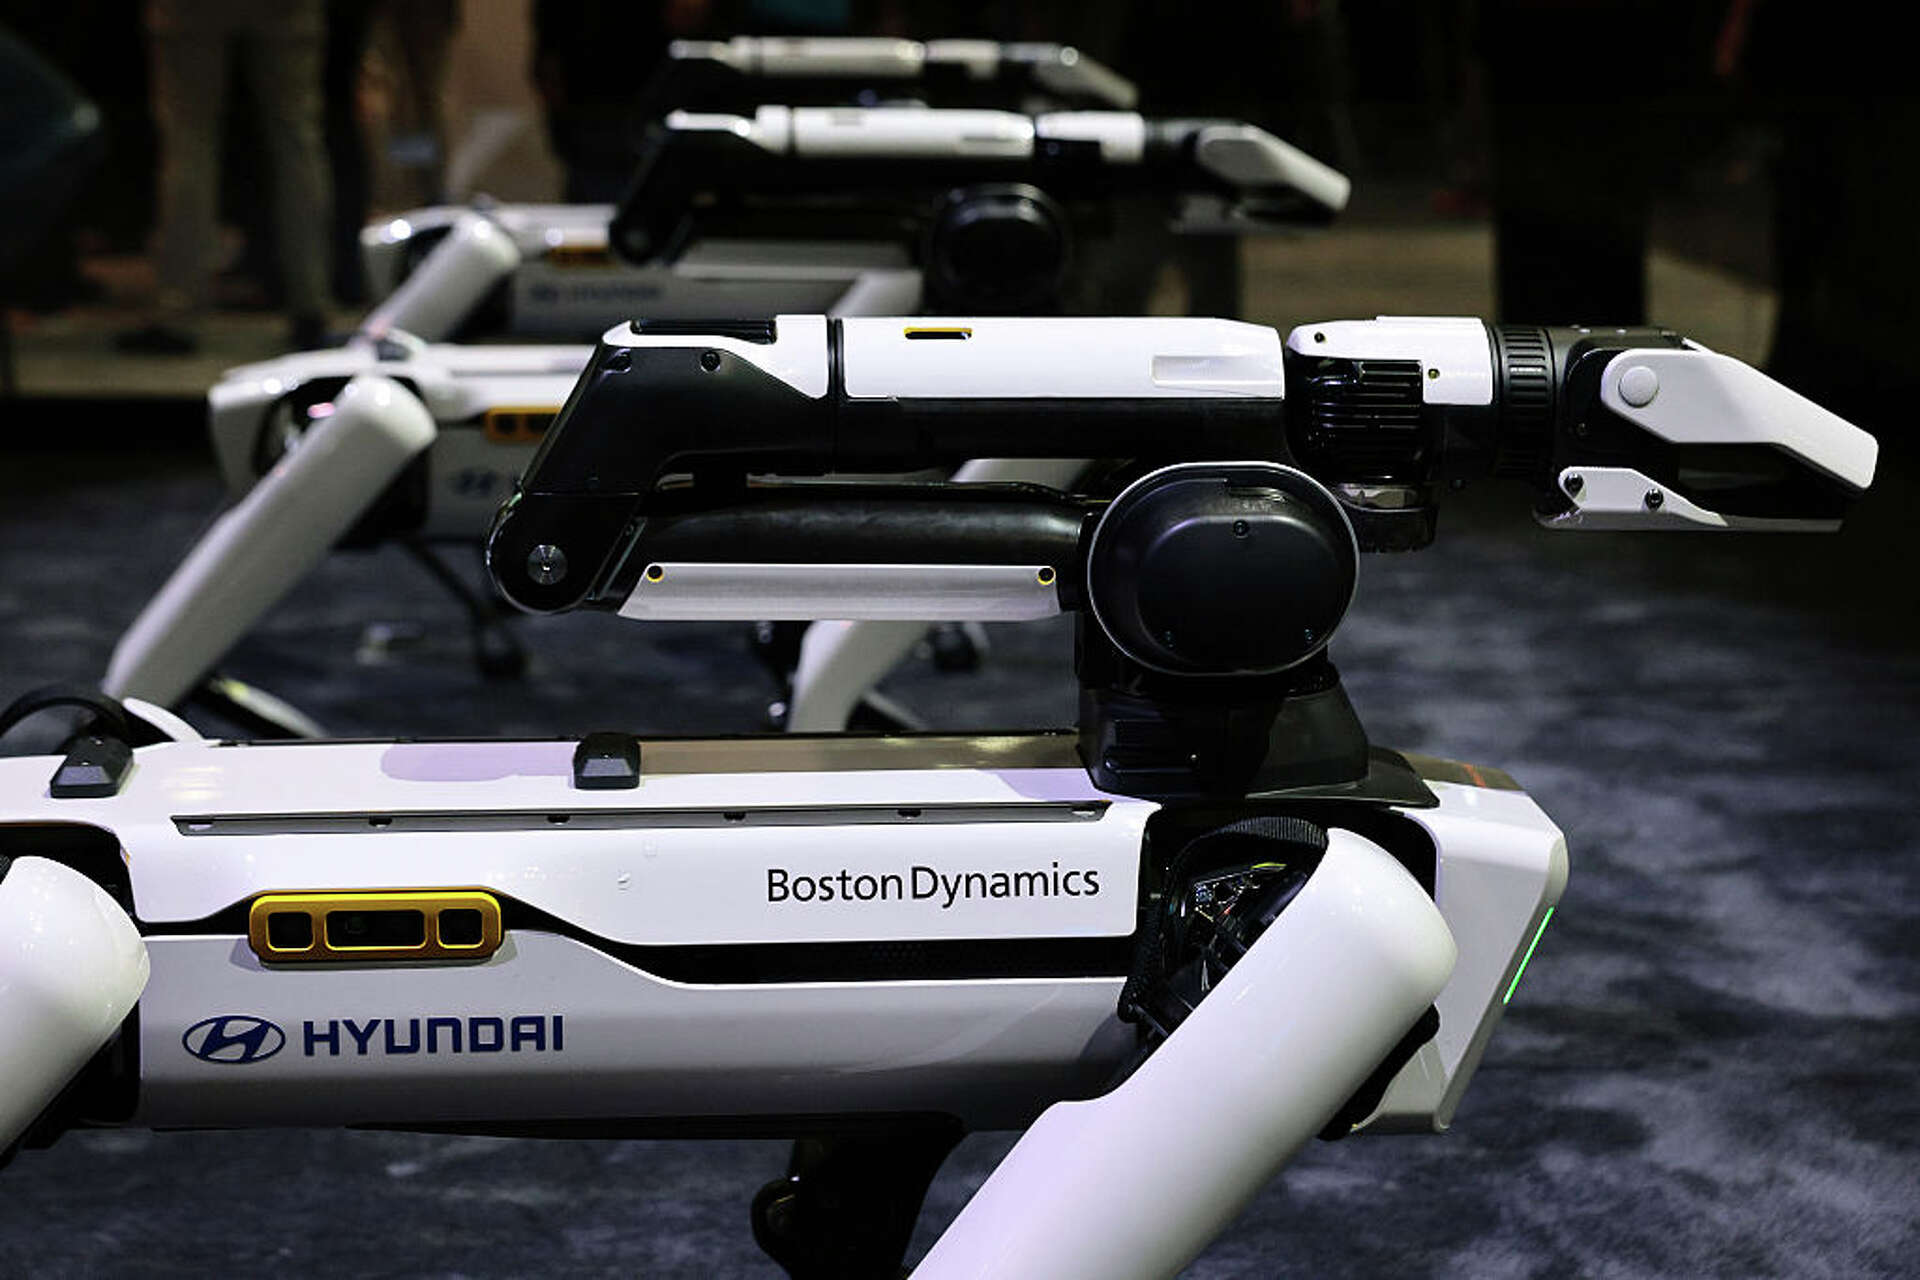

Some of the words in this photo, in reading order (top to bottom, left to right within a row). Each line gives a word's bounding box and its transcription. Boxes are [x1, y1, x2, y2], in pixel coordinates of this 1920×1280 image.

[767, 868, 903, 902] Boston
[911, 862, 1100, 909] Dynamics
[303, 1015, 563, 1055] HYUNDAI
